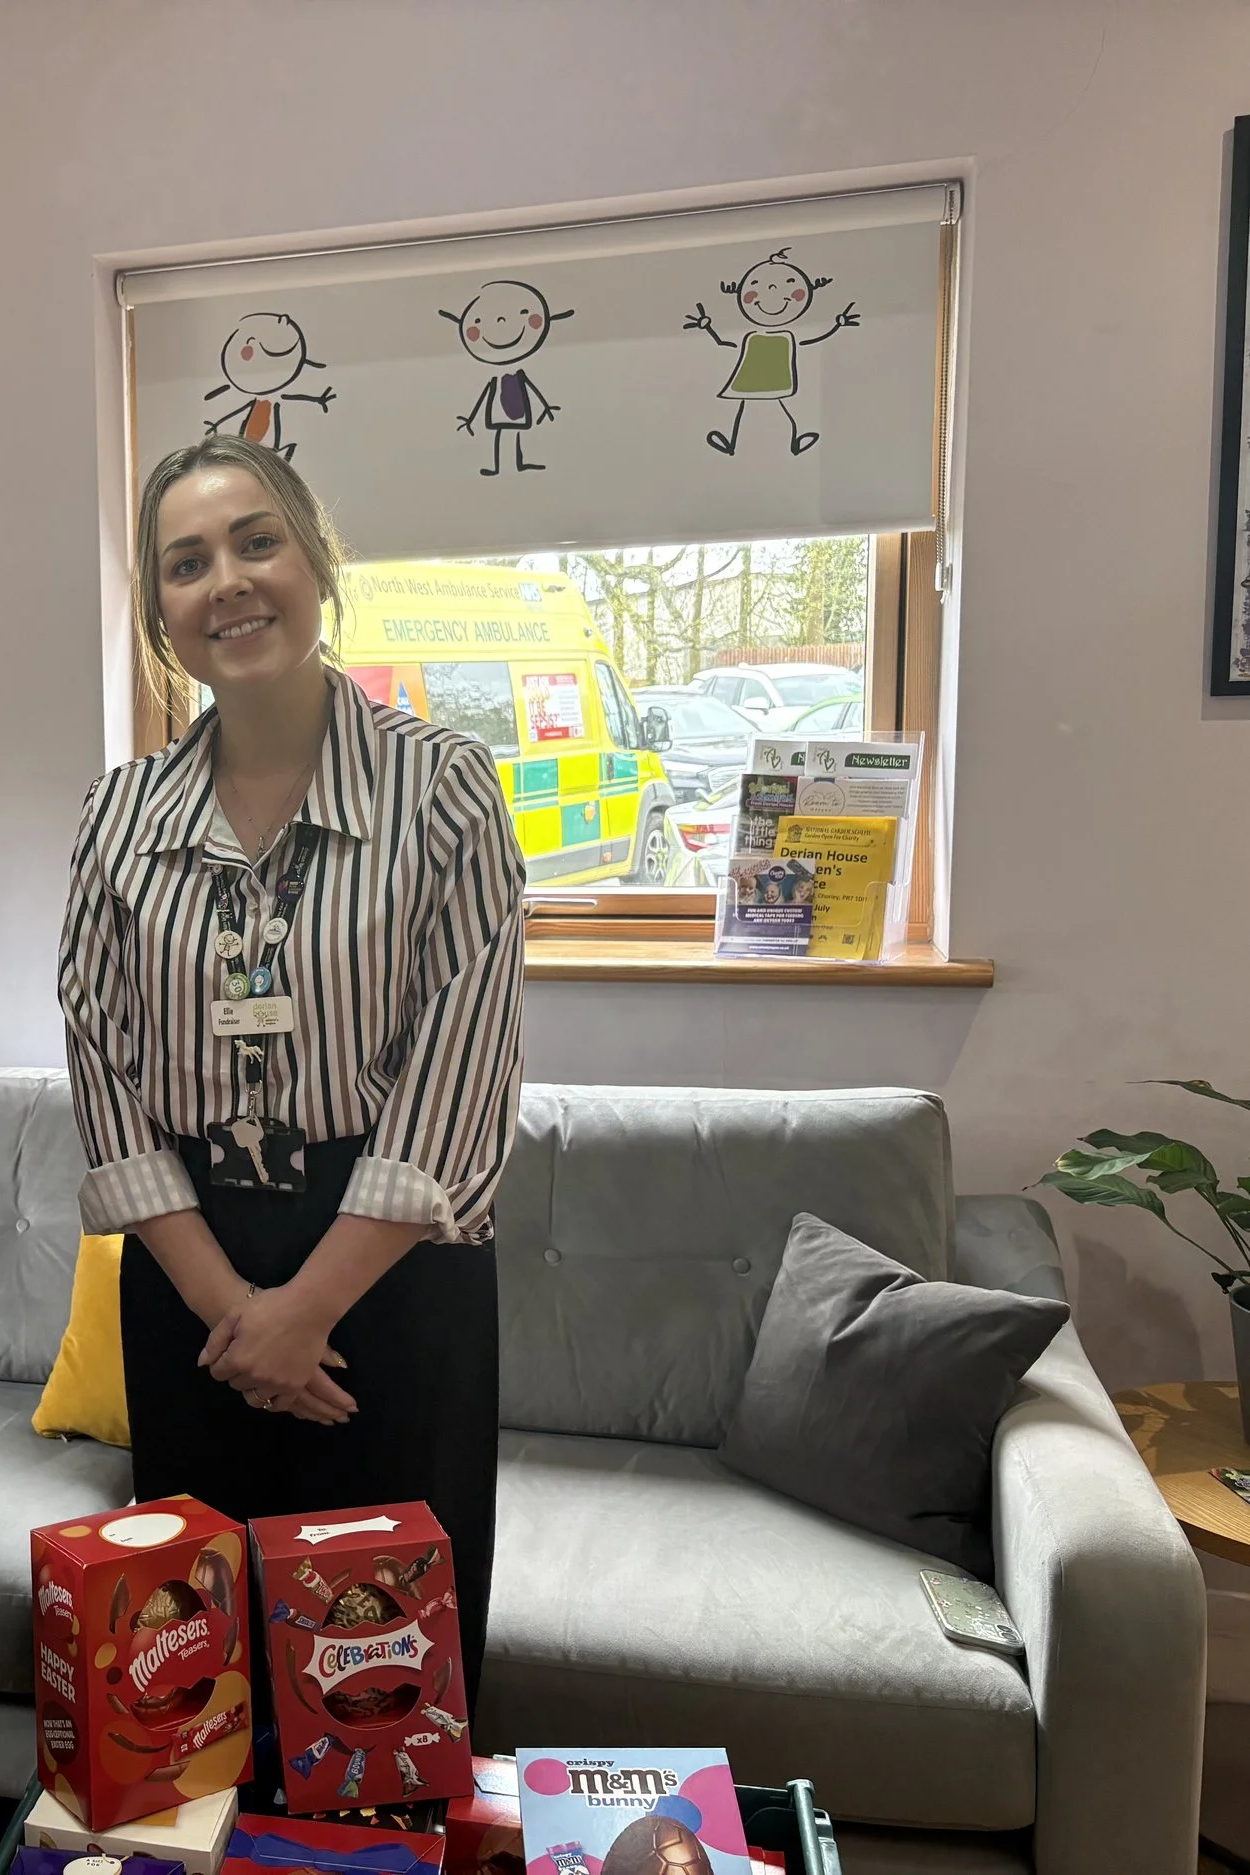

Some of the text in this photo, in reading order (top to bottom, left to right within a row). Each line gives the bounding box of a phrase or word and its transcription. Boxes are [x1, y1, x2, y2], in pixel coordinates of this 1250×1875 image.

[371, 575, 402, 594] North
[406, 578, 431, 596] West
[435, 580, 487, 599] Ambulance
[489, 583, 521, 600] Service
[382, 619, 550, 642] EMERGENCY AMBULANCE
[851, 755, 908, 768] Newsletter
[754, 816, 773, 827] the
[744, 835, 776, 849] thing
[780, 847, 868, 863] Derian House
[814, 904, 831, 912] July
[231, 981, 242, 993] 30
[38, 1581, 74, 1616] Maltesers
[53, 1605, 75, 1622] Teasers
[128, 1617, 210, 1694] Maltesers
[177, 1638, 210, 1661] Teasers
[40, 1641, 75, 1682] HAPPY
[41, 1660, 76, 1704] EASTER
[192, 1710, 228, 1750] Maltesers
[65, 1740, 74, 1750] EGG
[416, 1735, 428, 1744] x8
[566, 1758, 615, 1767] crispy
[587, 1795, 656, 1810] bunny
